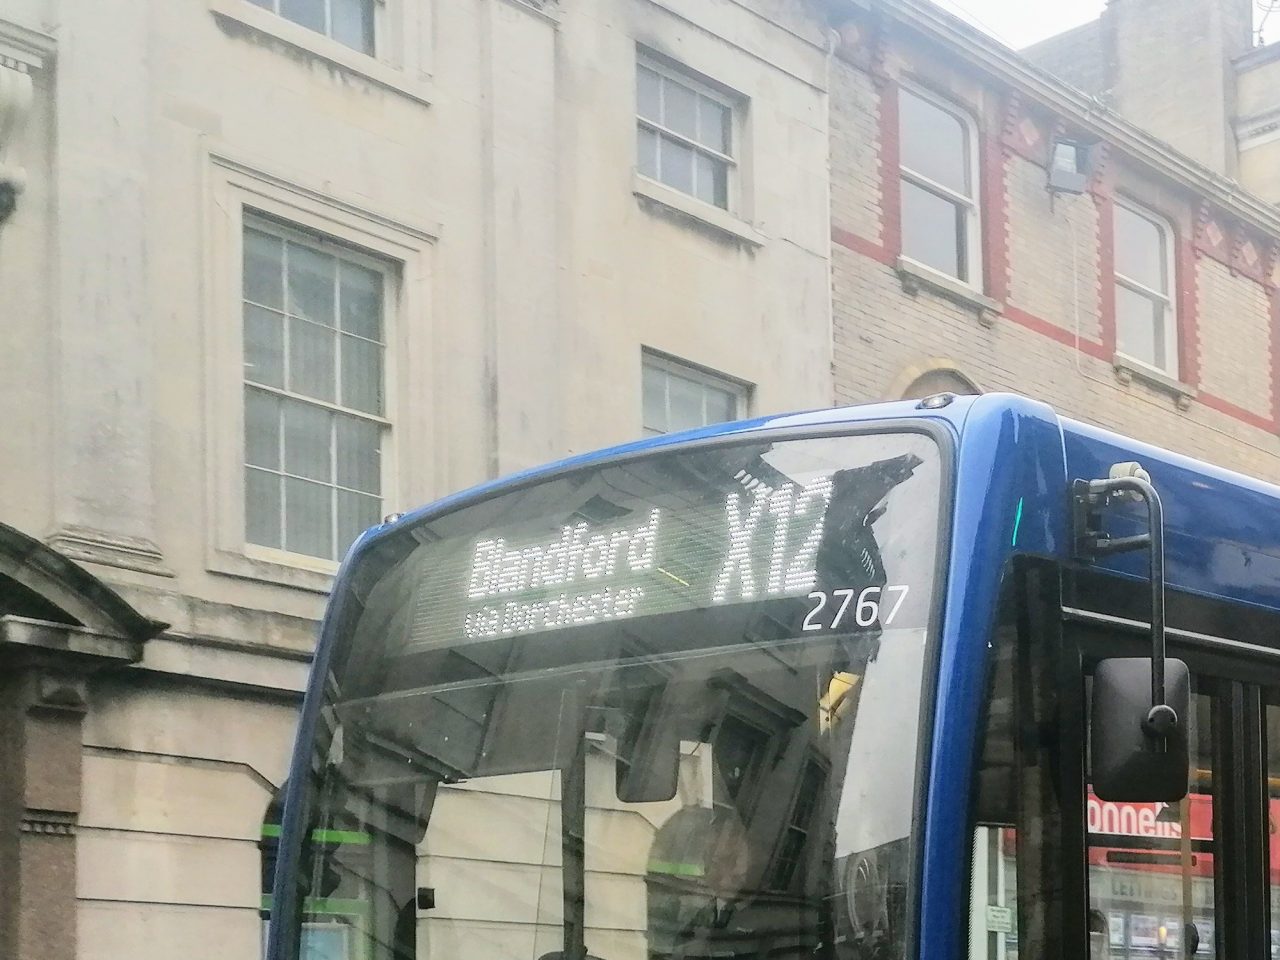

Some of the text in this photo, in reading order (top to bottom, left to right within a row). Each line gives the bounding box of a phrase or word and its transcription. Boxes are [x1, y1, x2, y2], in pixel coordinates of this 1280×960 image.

[467, 507, 661, 599] Blandford
[712, 476, 834, 601] X12
[501, 586, 645, 634] Dorchester
[802, 584, 910, 631] 2767
